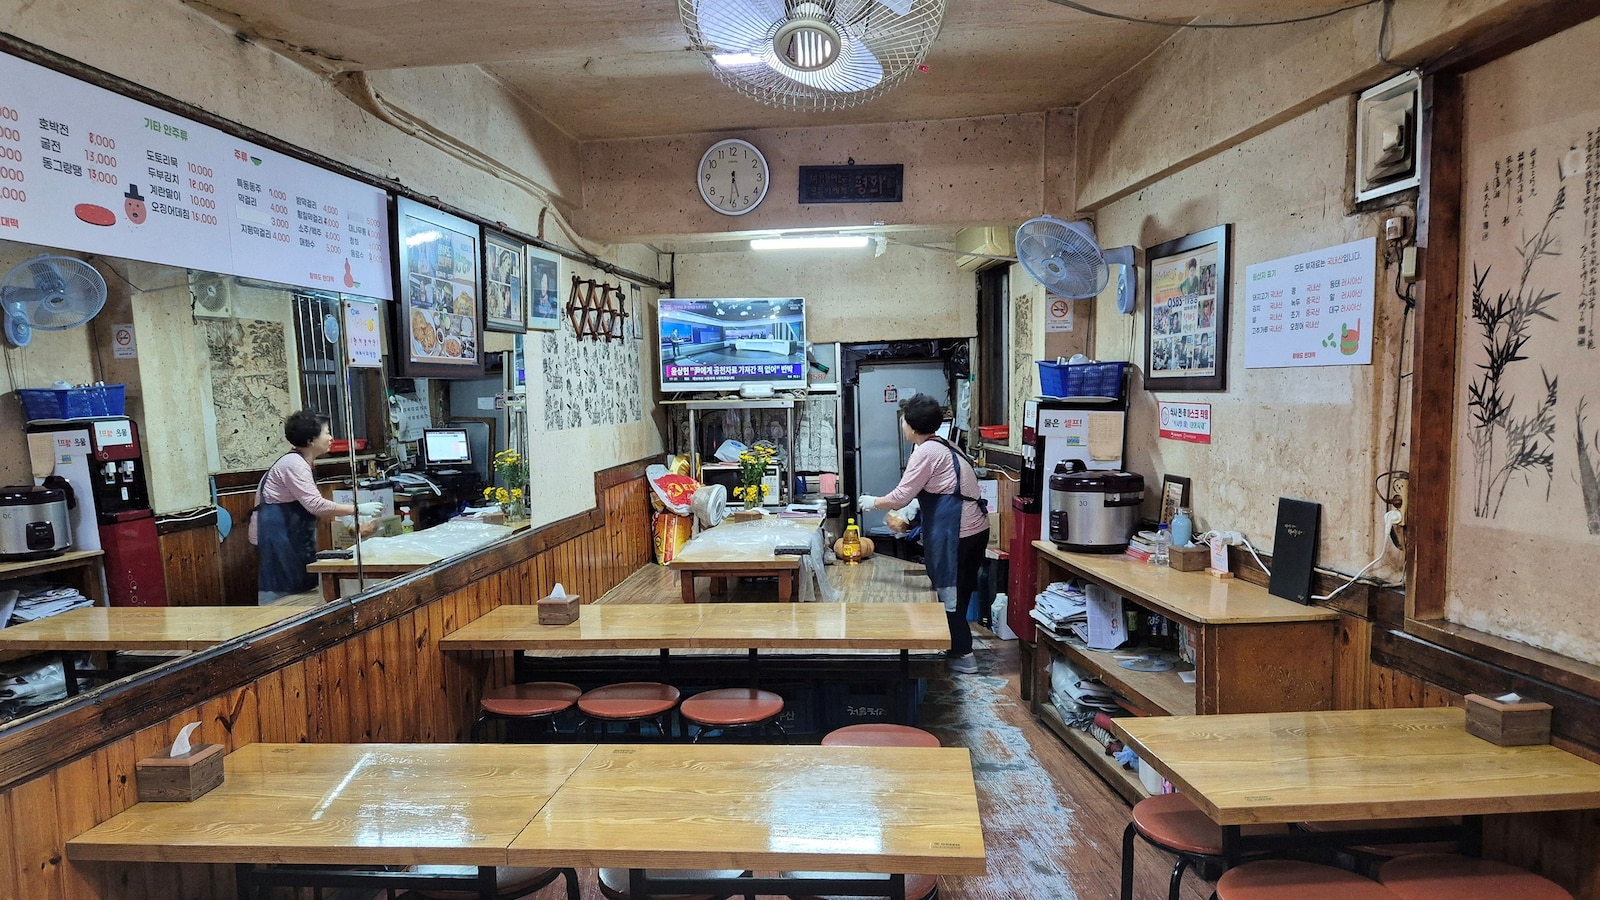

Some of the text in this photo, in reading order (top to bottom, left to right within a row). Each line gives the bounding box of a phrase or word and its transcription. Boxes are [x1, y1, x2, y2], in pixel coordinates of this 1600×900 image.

[39, 118, 69, 137] 호박전
[144, 118, 188, 141] 기타 안주류
[40, 137, 61, 153] 굴전
[234, 149, 248, 163] 주류
[718, 150, 725, 160] 11
[729, 147, 737, 156] 12
[147, 150, 178, 168] 도토리묵
[752, 159, 758, 169] 2
[42, 156, 82, 176] 동그랑땡
[708, 160, 718, 169] 10
[148, 167, 180, 185] 두부김치
[705, 173, 711, 182] 9
[756, 173, 763, 182] 3
[150, 185, 181, 202] 계란말이
[709, 187, 715, 196] 8
[752, 187, 758, 196] 4
[238, 194, 257, 207] 막걸리
[719, 196, 725, 205] 7
[731, 199, 737, 208] 6
[743, 196, 749, 205] 5
[151, 202, 190, 220] 오징어데침
[0, 217, 19, 228] 대떡
[298, 224, 322, 238] 소주/맥주
[351, 250, 364, 259] 음료수
[1294, 264, 1304, 273] 모든
[1305, 260, 1326, 270] 부재료는
[1252, 270, 1277, 281] 원산지 표기
[1341, 276, 1362, 287] 러시아산
[1307, 283, 1321, 292] 국내산
[1270, 290, 1283, 299] 국내산
[1341, 289, 1362, 300] 러시아산
[1306, 296, 1320, 305] 중국산
[1270, 302, 1282, 310] 국내산
[1329, 303, 1361, 314] 대구 러시아산
[1269, 313, 1282, 321] 국내산
[1305, 308, 1320, 317] 중국산
[1269, 325, 1282, 333] 국내산
[1290, 320, 1320, 331] 오징어 국내산
[670, 366, 689, 376] 윤상현
[781, 365, 793, 374] 반박
[1044, 418, 1082, 428] 물은 셀프!
